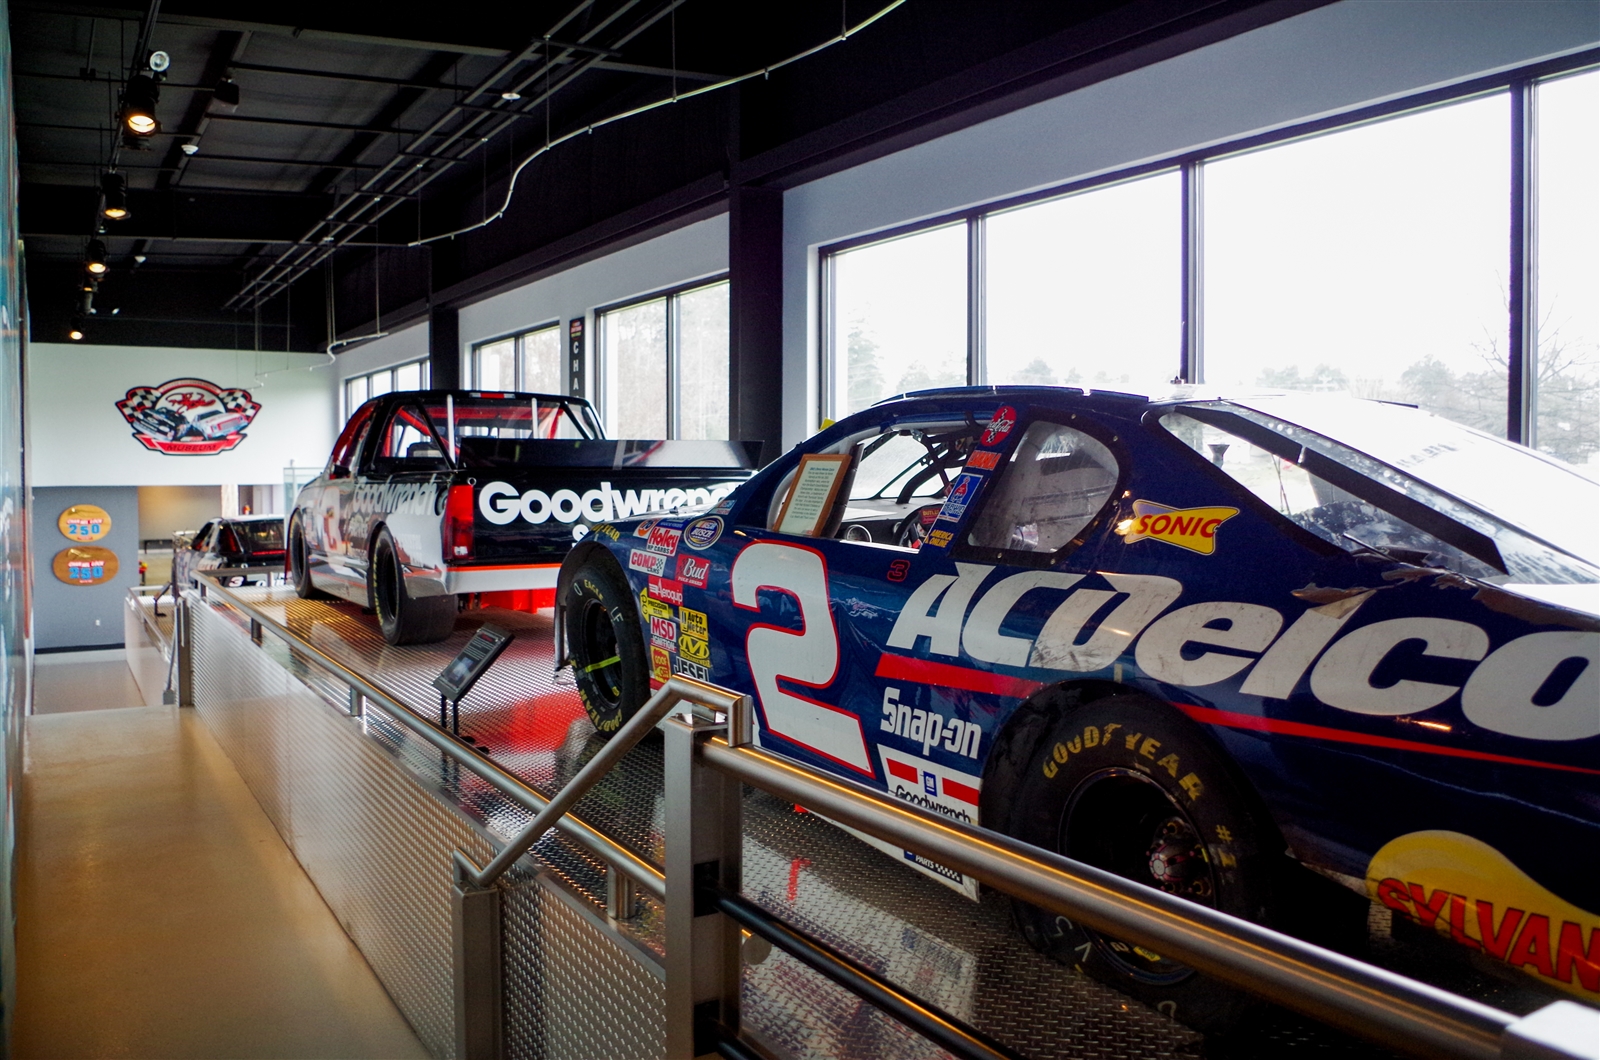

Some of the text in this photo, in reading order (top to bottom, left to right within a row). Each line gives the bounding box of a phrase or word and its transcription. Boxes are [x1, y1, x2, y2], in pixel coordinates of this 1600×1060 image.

[69, 524, 100, 535] 250
[1135, 514, 1223, 538] SONIC
[648, 526, 680, 554] Holley
[631, 551, 656, 568] COMP
[683, 557, 709, 580] Bud
[887, 559, 911, 582] 3
[69, 566, 103, 579] 250
[229, 576, 244, 587] 3
[652, 617, 675, 640] MSD
[688, 612, 703, 625] Auto
[730, 539, 876, 780] 2
[880, 686, 982, 760] Snap-on
[915, 855, 935, 870] PARTS
